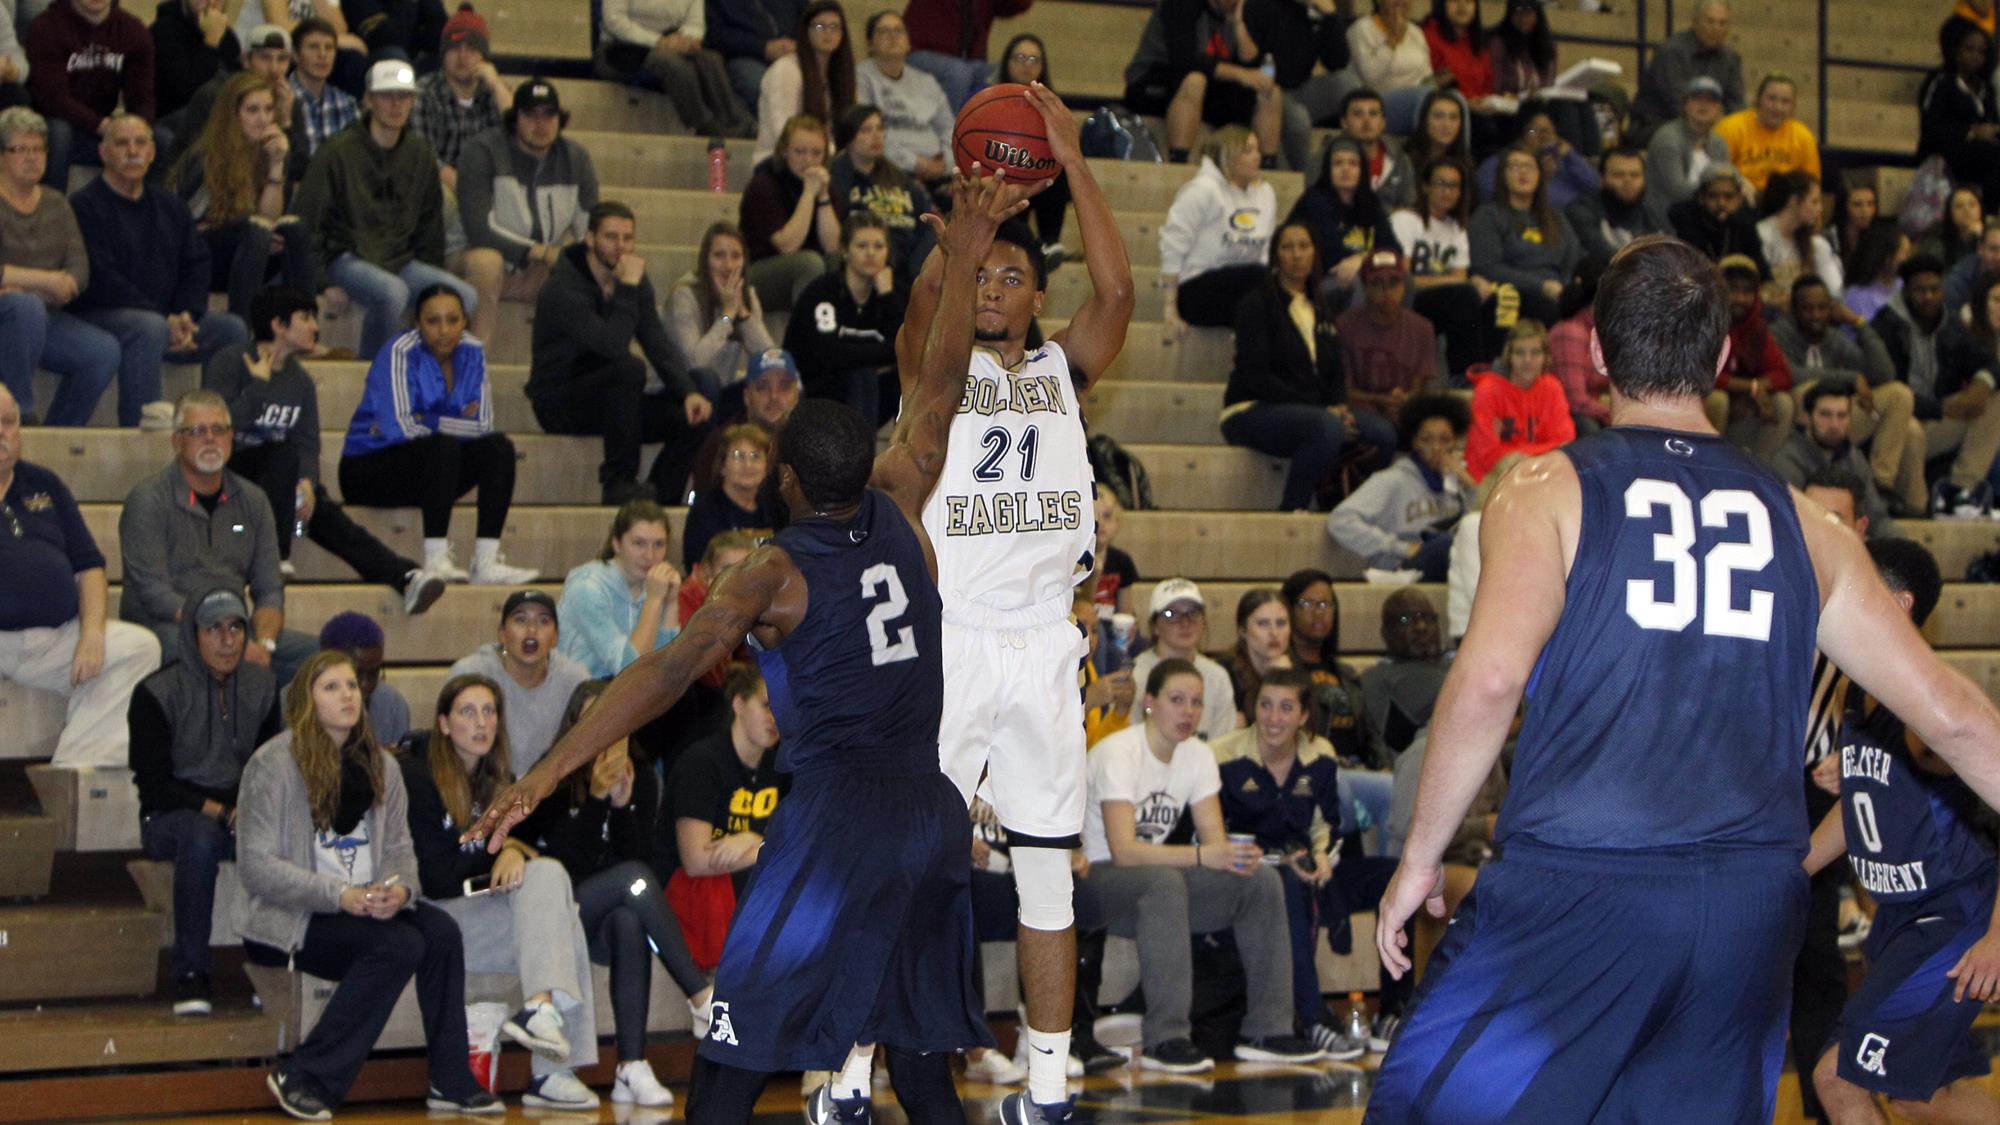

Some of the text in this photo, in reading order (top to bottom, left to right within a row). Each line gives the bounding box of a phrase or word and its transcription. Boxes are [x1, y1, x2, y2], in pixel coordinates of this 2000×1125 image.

[984, 138, 1057, 170] Wilson
[973, 424, 1039, 482] 21
[946, 490, 1081, 537] EAGLES
[1624, 477, 1775, 642] 32
[860, 562, 919, 666] 2
[1853, 791, 1882, 853] 0
[103, 1038, 117, 1056] A
